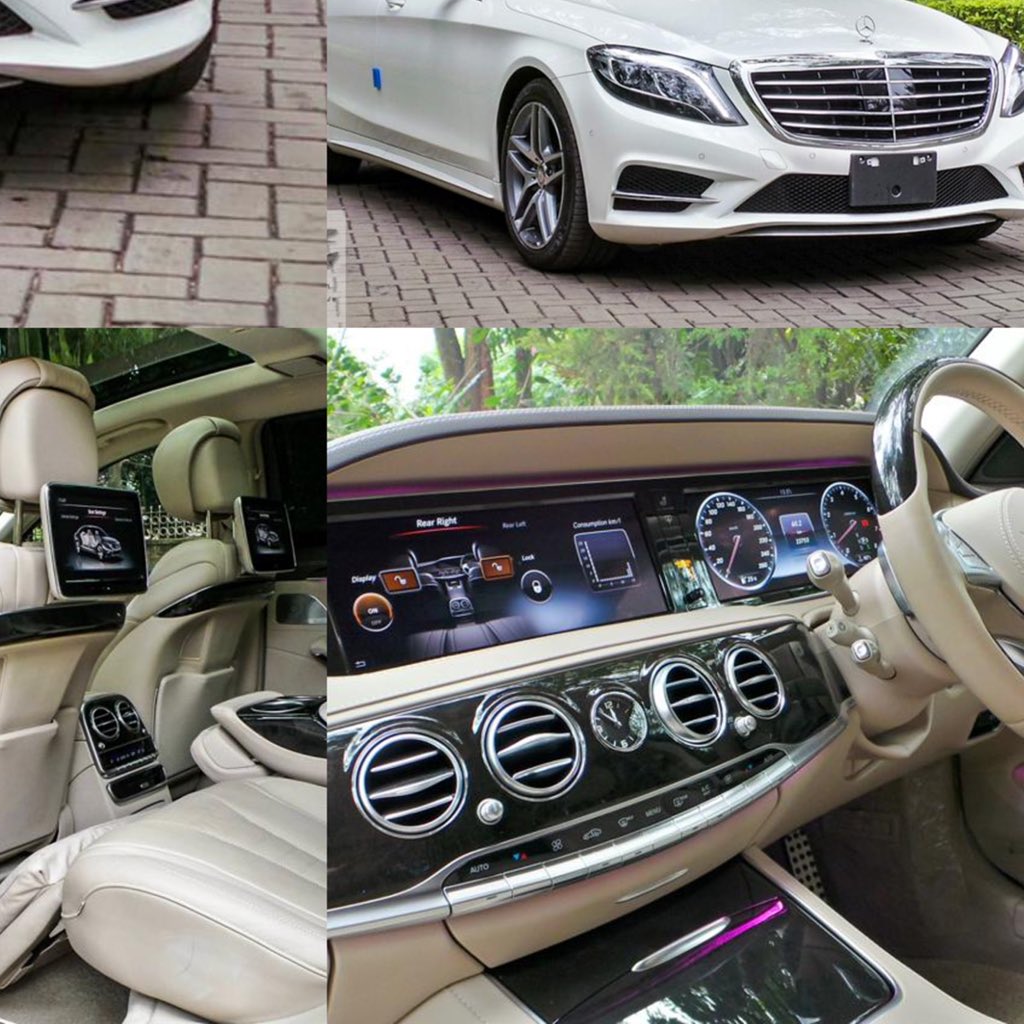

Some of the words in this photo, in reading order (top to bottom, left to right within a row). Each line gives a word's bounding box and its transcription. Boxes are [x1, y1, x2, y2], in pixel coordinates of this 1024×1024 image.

[416, 519, 435, 528] Rear
[436, 517, 457, 527] Right
[573, 519, 608, 529] Consumption
[351, 574, 377, 584] Display
[470, 863, 490, 874] AUTO
